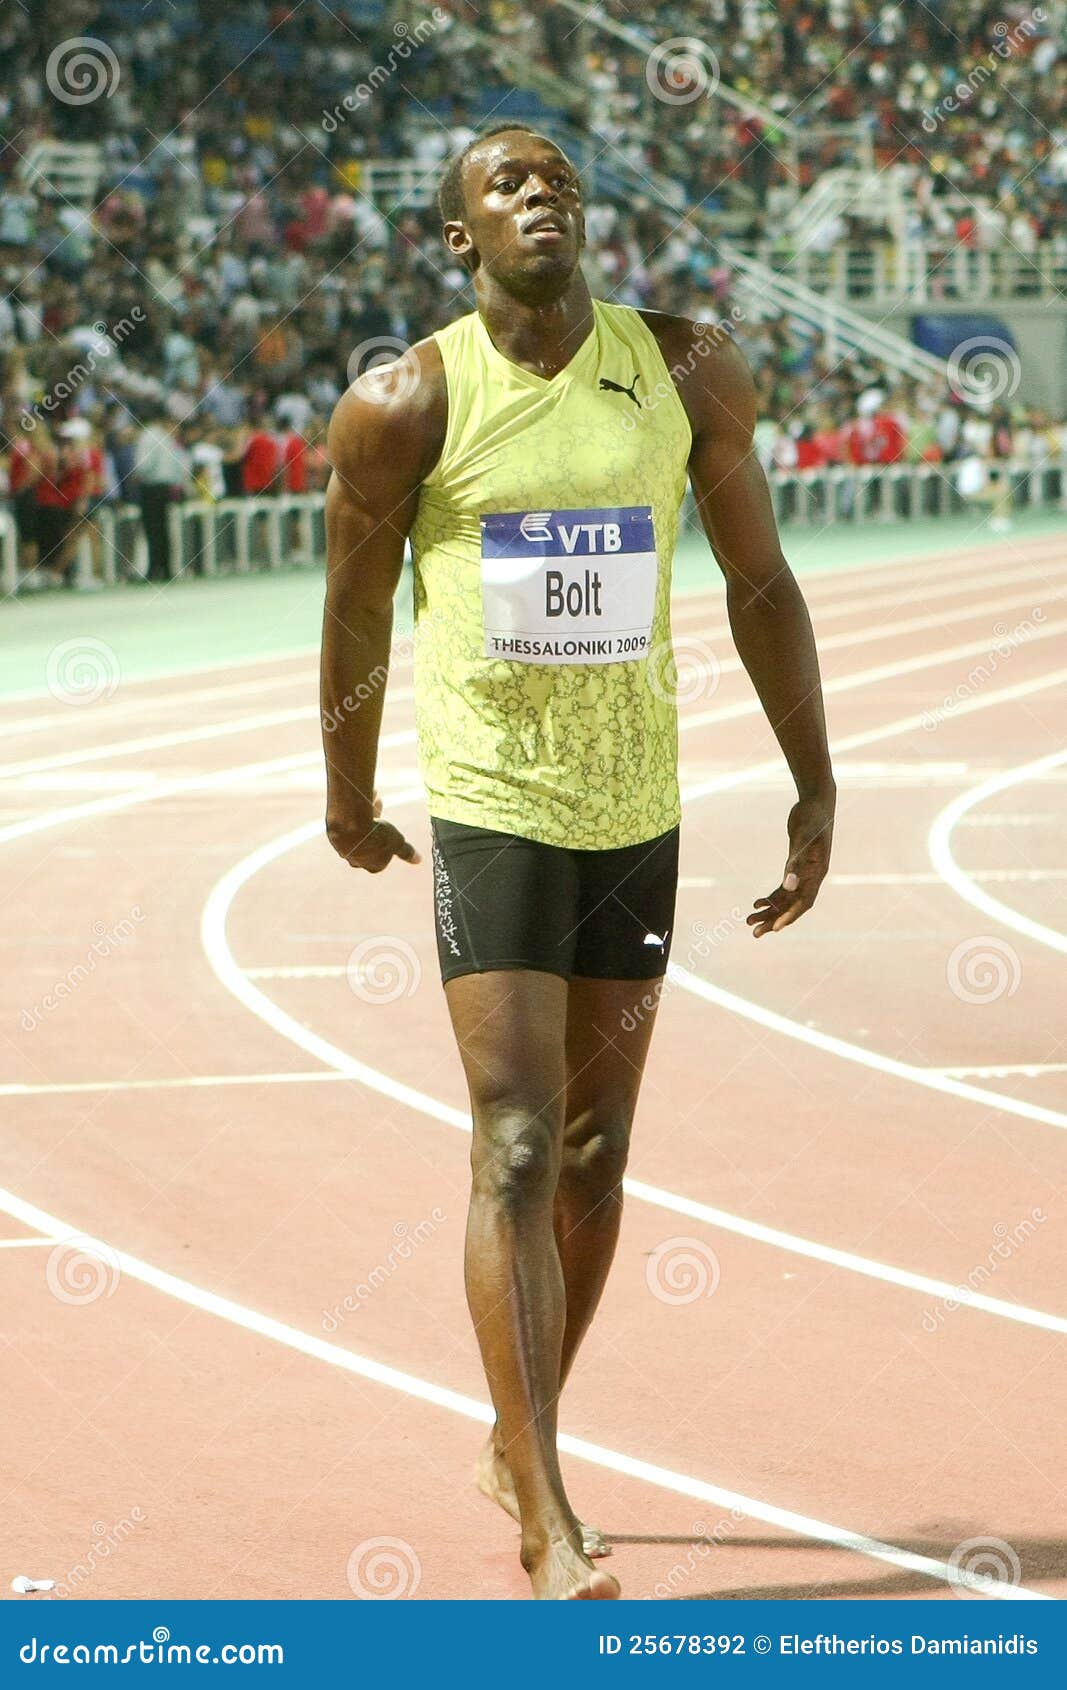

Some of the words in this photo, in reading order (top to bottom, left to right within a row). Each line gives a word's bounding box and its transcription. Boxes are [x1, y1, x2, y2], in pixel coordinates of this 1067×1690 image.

[557, 523, 622, 554] VTB
[545, 569, 602, 617] Bolt
[491, 637, 612, 656] THESSALONIKI
[617, 635, 648, 653] 2009
